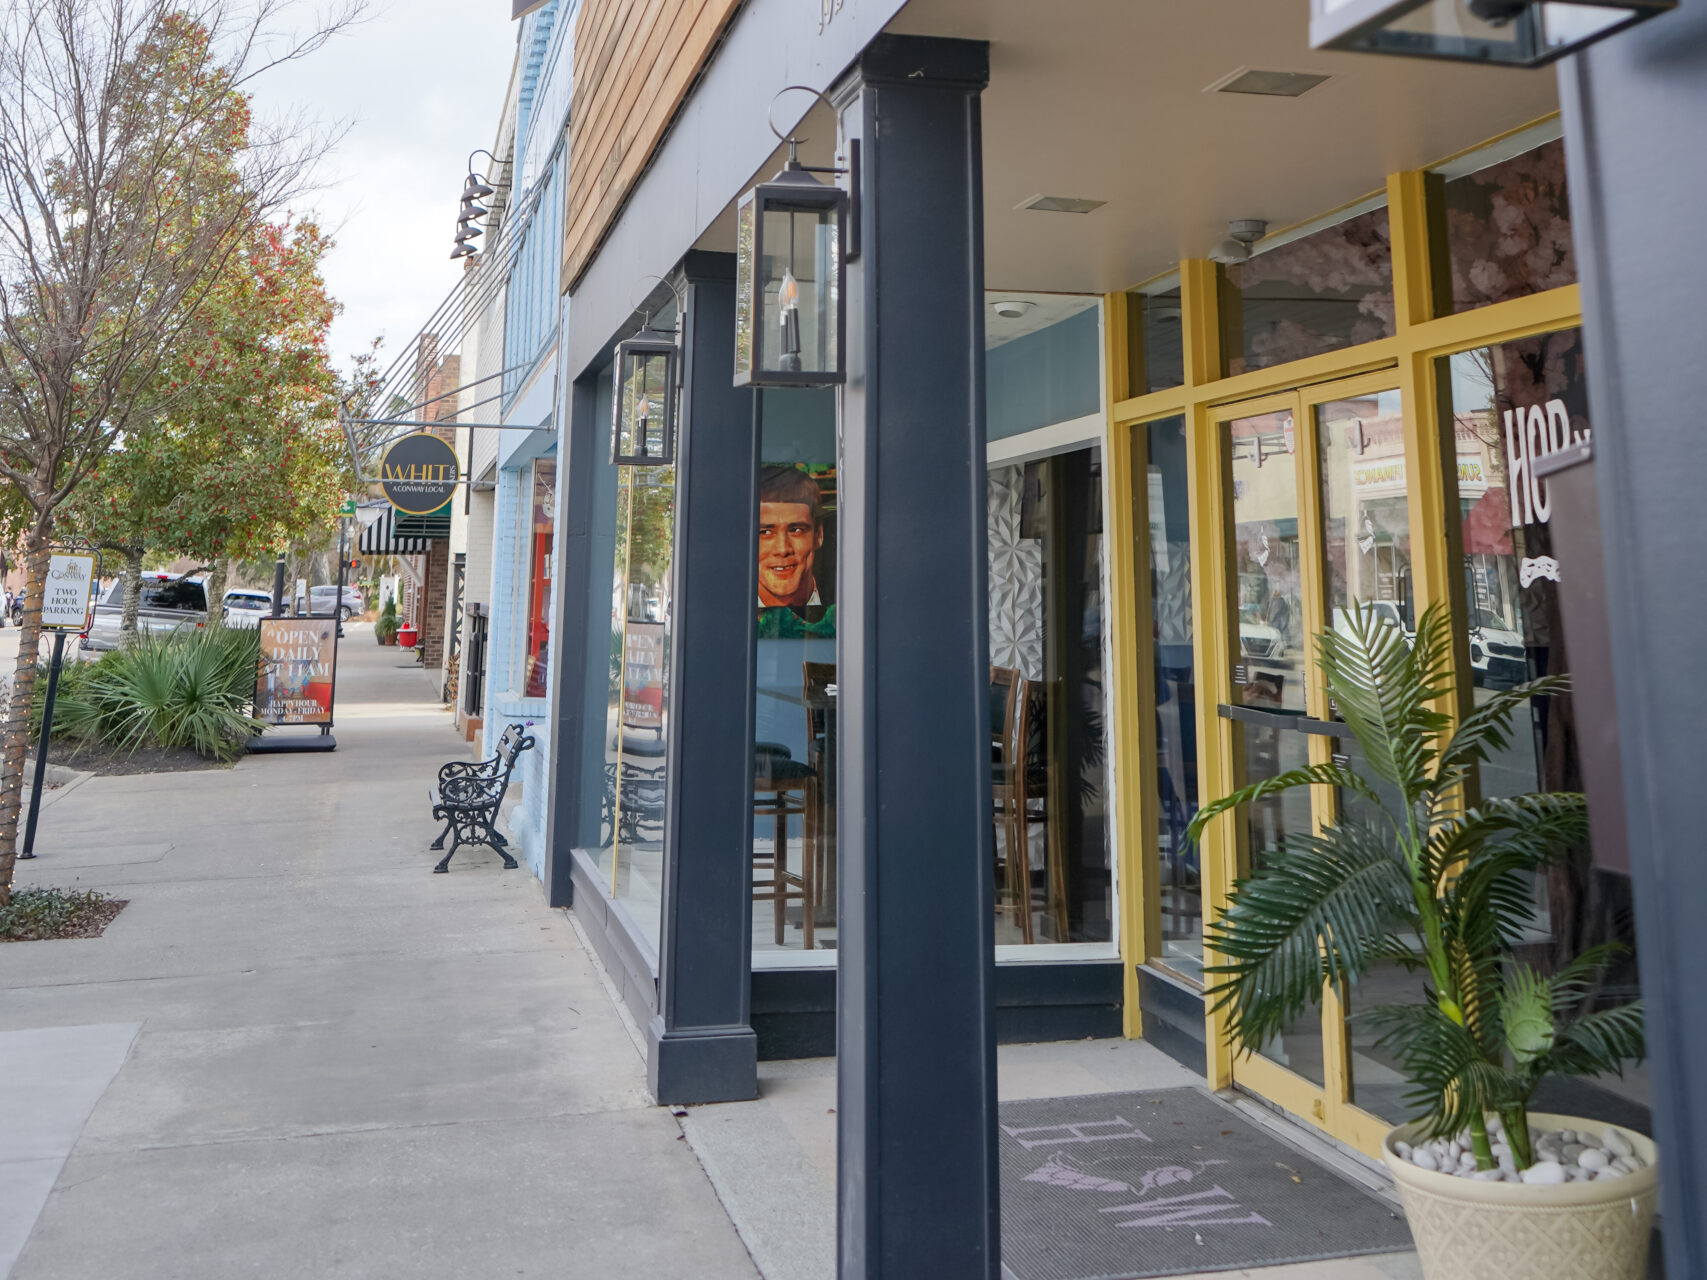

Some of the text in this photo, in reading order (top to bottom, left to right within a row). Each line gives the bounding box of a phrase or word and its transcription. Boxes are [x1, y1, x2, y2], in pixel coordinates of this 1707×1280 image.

[55, 588, 78, 596] TWO
[51, 597, 78, 606] HOUR
[43, 606, 84, 615] PARKING
[276, 630, 320, 644] OPEN
[273, 646, 323, 660] DAILY
